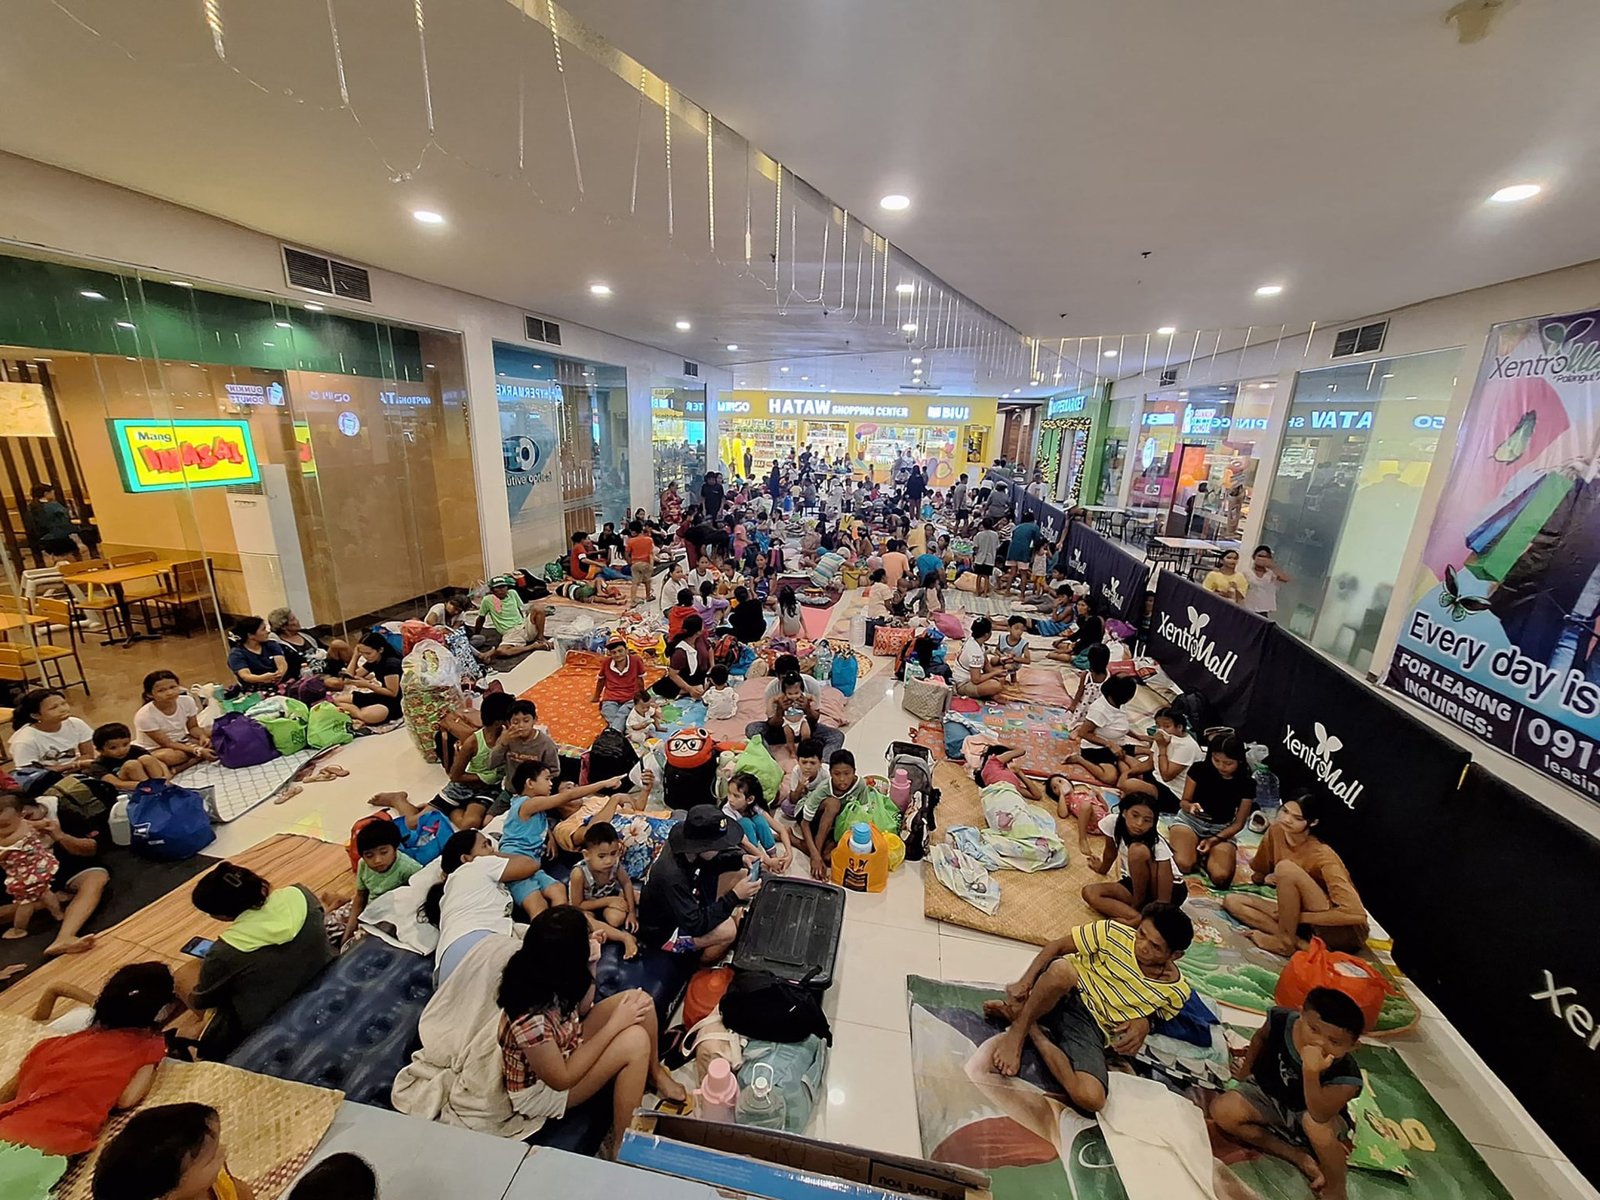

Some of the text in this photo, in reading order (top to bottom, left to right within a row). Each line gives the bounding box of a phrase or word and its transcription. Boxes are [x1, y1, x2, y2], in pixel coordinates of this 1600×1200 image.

[137, 432, 172, 443] Mang
[769, 399, 831, 415] HATAW
[832, 404, 875, 416] SHOPPING
[875, 407, 909, 418] CENTER
[1157, 611, 1239, 684] XentroMall
[1408, 611, 1600, 715] Every day is
[1400, 653, 1513, 722] FOR LEASING
[1404, 677, 1494, 739] INQUIRIES:
[1283, 724, 1365, 810] XentroMall
[878, 1176, 903, 1191] YOU
